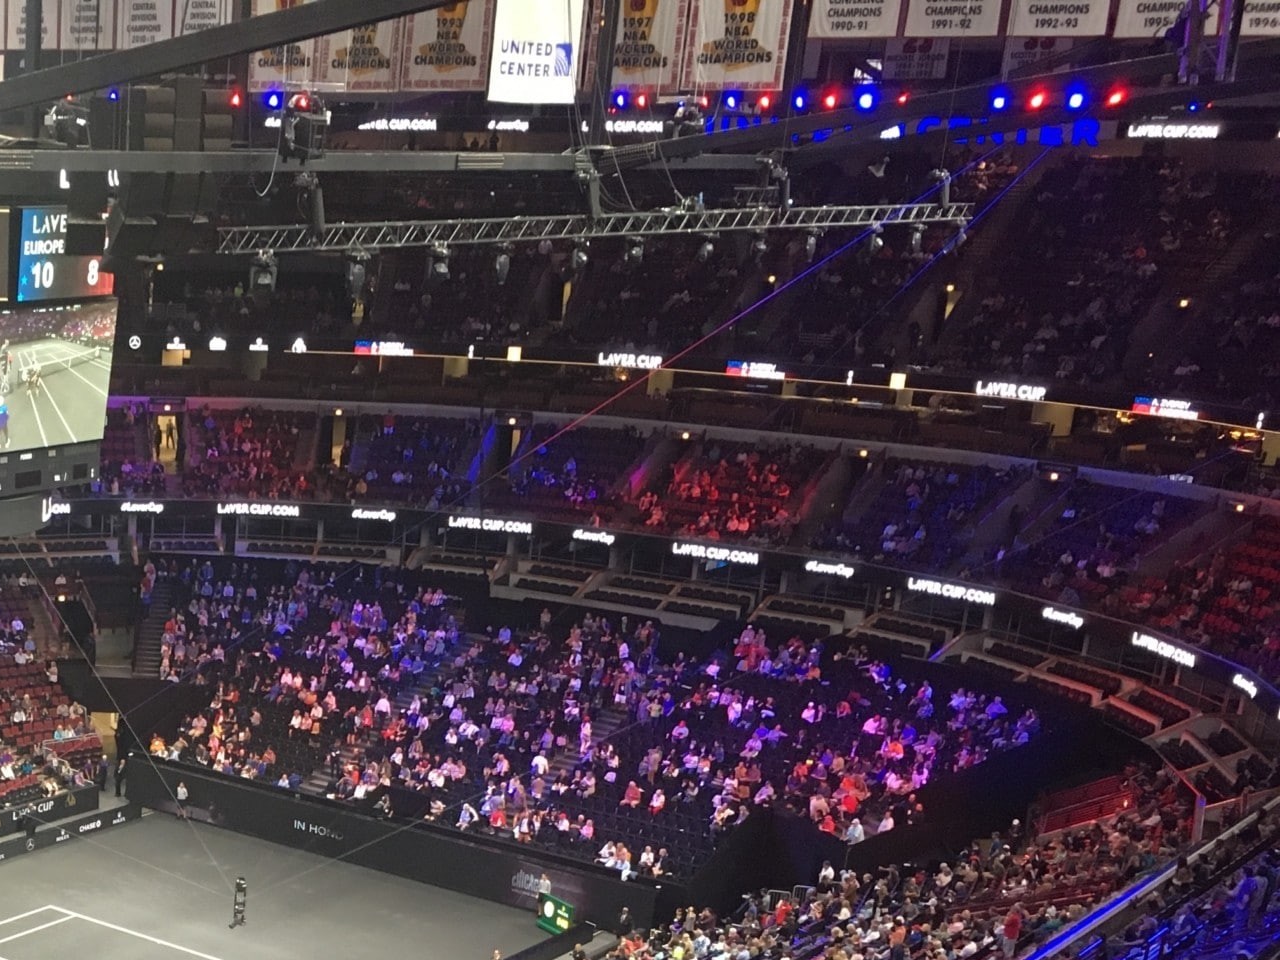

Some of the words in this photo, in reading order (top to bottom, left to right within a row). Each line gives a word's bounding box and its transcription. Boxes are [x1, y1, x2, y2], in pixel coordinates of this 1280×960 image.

[827, 7, 882, 18] CHAMPIONS
[925, 5, 982, 16] CHAMPIONS
[1029, 3, 1090, 15] CHAMPIONS
[1137, 2, 1186, 13] CHAMPIO
[436, 18, 462, 29] 1993
[623, 17, 651, 28] 1997
[724, 12, 755, 24] 1998
[931, 19, 972, 29] 1991-92
[1035, 18, 1078, 29] 1992-93
[185, 22, 219, 31] CHAMPIO
[724, 26, 750, 37] NBA
[830, 20, 868, 31] 1990-91
[352, 34, 372, 44] NBA
[437, 30, 457, 40] NBA
[623, 30, 647, 41] NBA
[428, 42, 465, 53] WORLD
[501, 40, 553, 56] UNITED
[713, 38, 759, 51] WORLD
[345, 46, 379, 57] WORLD
[258, 56, 311, 68] CHAMPIONS
[332, 58, 391, 69] CHAMPIONS
[414, 55, 476, 66] CHAMPIONS
[613, 54, 668, 67] AMPIONS
[698, 51, 772, 65] CHAMPIONS
[500, 60, 550, 77] CENTER
[389, 119, 437, 131] CUP.COM
[613, 121, 664, 133] CUP.COM
[1166, 125, 1219, 139] CUP.COM
[32, 214, 67, 235] LAVE
[23, 239, 65, 256] EUROPE
[31, 261, 54, 289] 10
[87, 259, 99, 286] 8
[598, 352, 637, 367] LAVER
[976, 380, 1017, 398] LAVER
[217, 503, 249, 514] LAVER
[249, 503, 300, 517] CUP.COM
[449, 516, 481, 529] LAVER
[482, 519, 532, 534] CUP.COM
[672, 542, 706, 559] LAVER
[706, 547, 759, 565] CUP.COM
[907, 576, 942, 597] LAVER
[942, 584, 996, 606] CUP.COM
[1132, 631, 1160, 654] LAVER
[1160, 640, 1195, 668] CUP.COM
[37, 801, 55, 813] CUP
[79, 822, 96, 833] CHASE
[294, 819, 306, 831] IN
